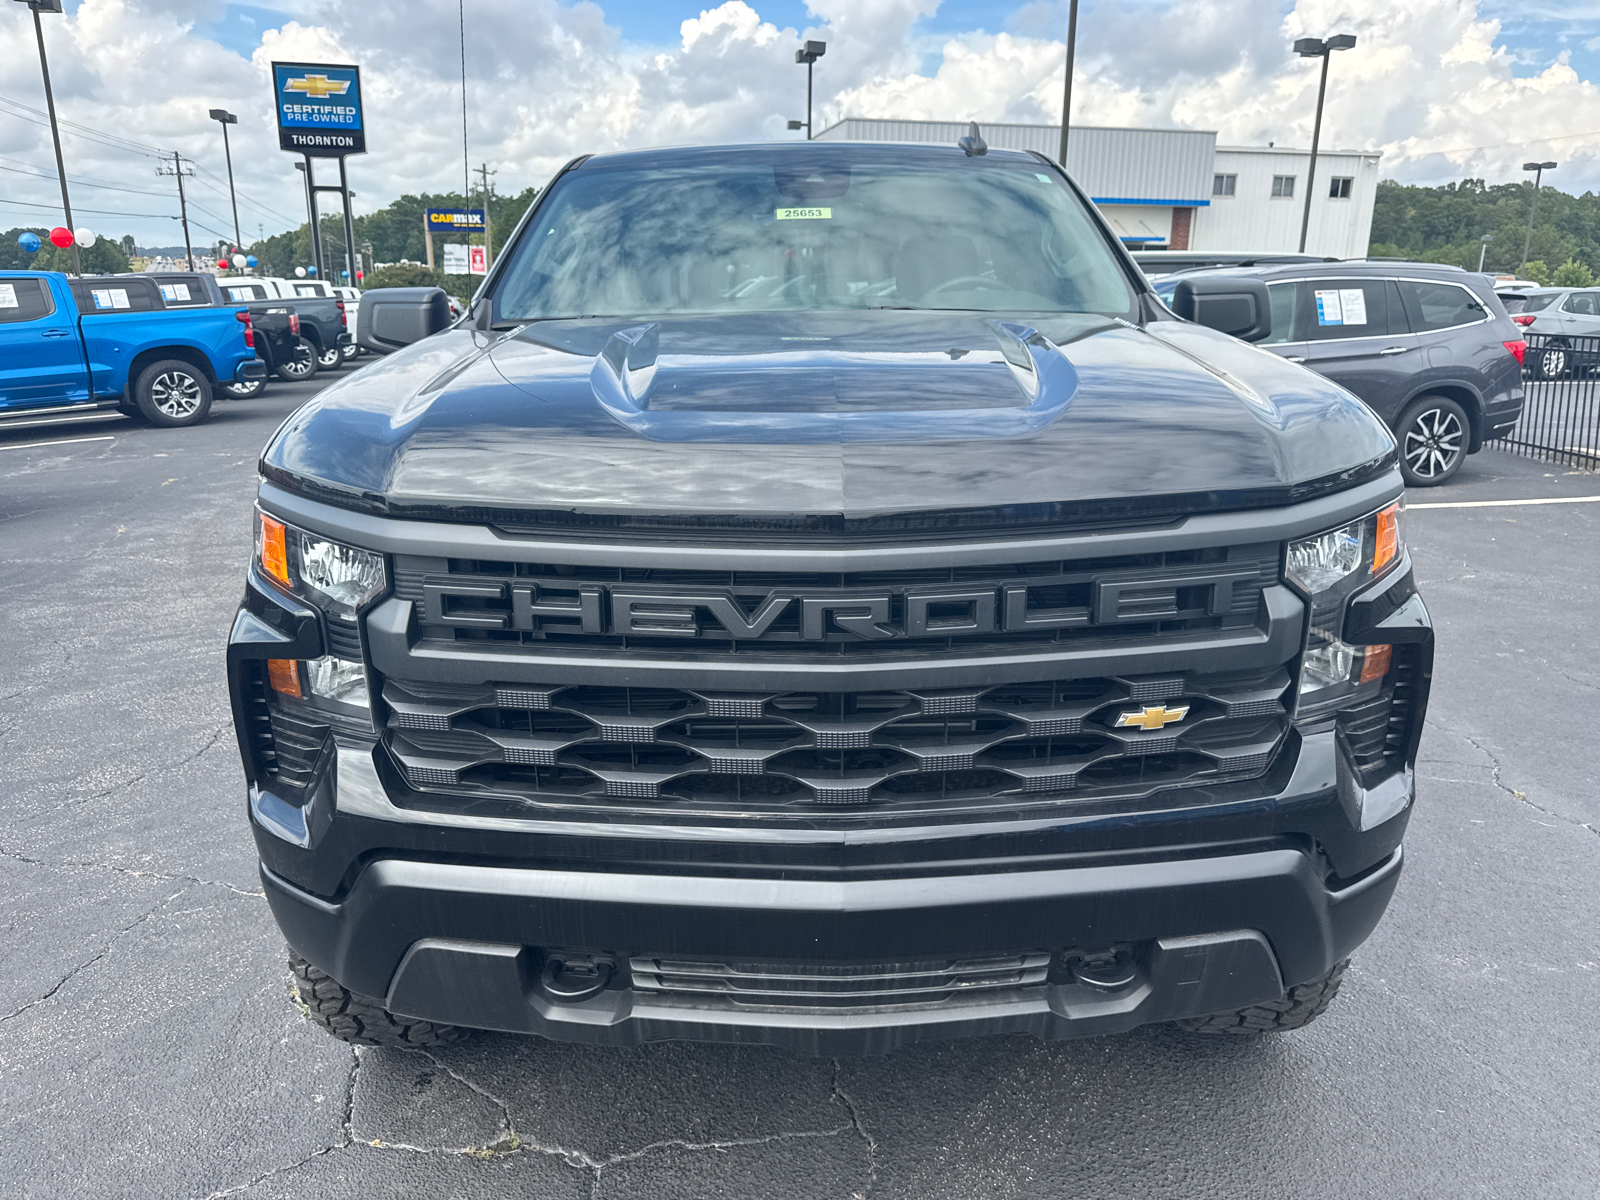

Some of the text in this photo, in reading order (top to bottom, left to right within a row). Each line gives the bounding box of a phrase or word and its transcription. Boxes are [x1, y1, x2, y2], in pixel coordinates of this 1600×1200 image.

[283, 104, 356, 115] CERTIFIED
[287, 113, 353, 123] PRE-OWNED
[291, 135, 354, 146] THORNTON
[422, 563, 1260, 641] CHEVROLET
